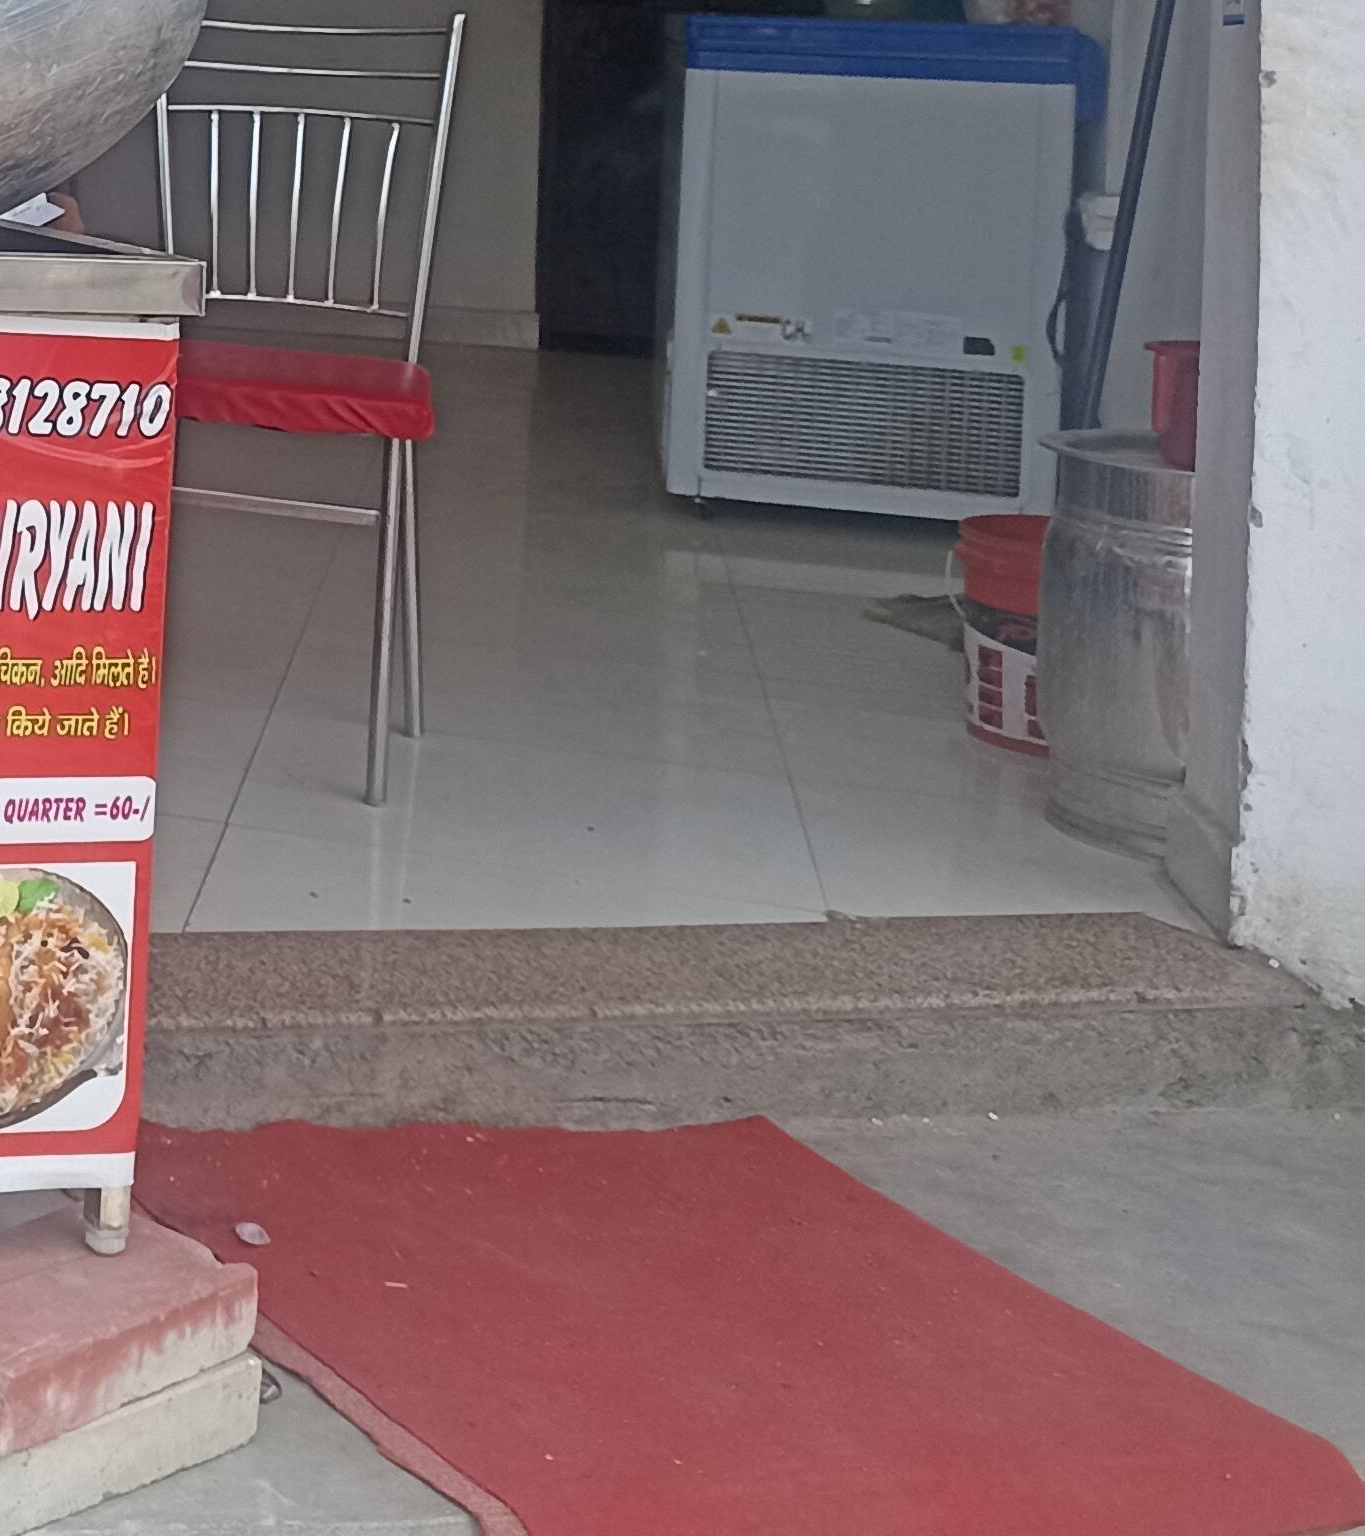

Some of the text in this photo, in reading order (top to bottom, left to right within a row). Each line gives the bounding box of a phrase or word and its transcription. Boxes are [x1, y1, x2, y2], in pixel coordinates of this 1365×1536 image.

[51, 646, 88, 687] आदि
[92, 646, 134, 688] मिलते
[7, 705, 51, 737] किये
[56, 707, 99, 737] जाते
[3, 797, 87, 823] QUARTER
